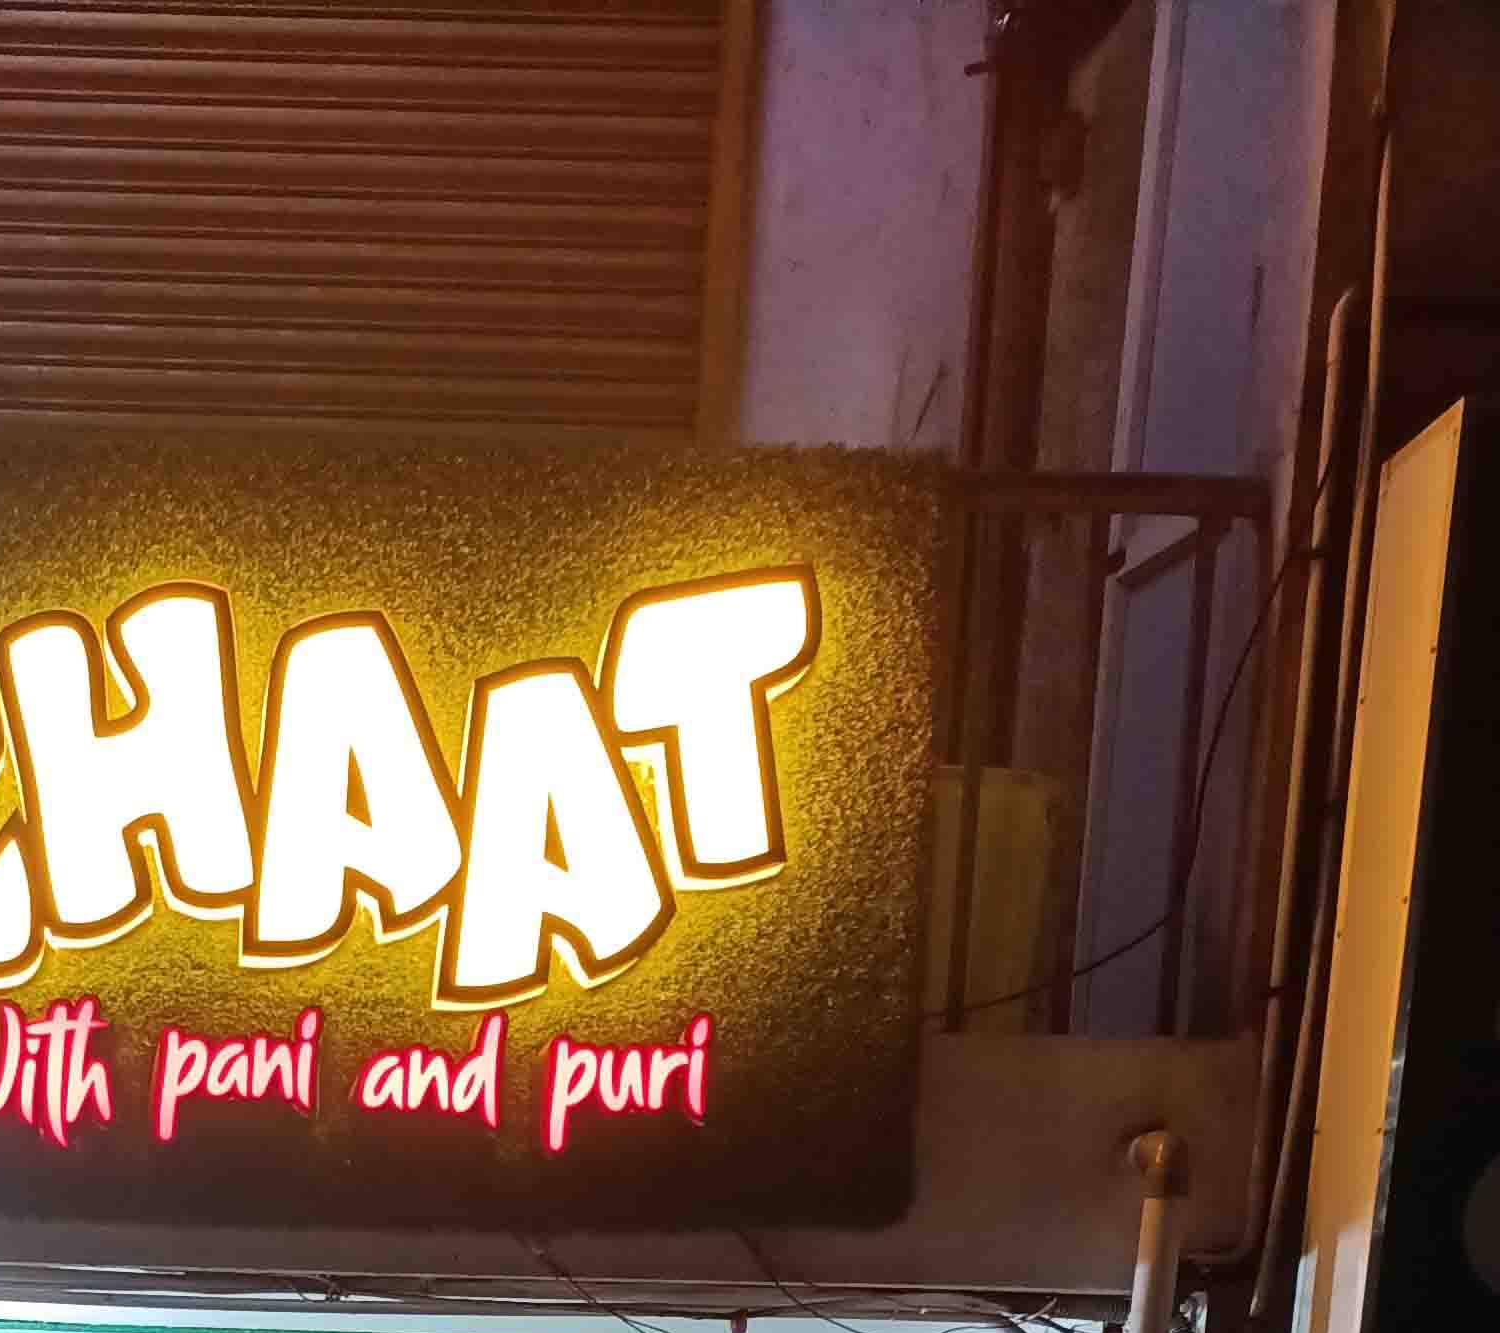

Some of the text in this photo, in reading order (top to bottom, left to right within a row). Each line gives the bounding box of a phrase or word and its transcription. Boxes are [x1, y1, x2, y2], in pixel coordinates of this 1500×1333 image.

[155, 1007, 322, 1149] pani
[361, 1015, 504, 1134] and
[548, 1015, 710, 1151] puri
